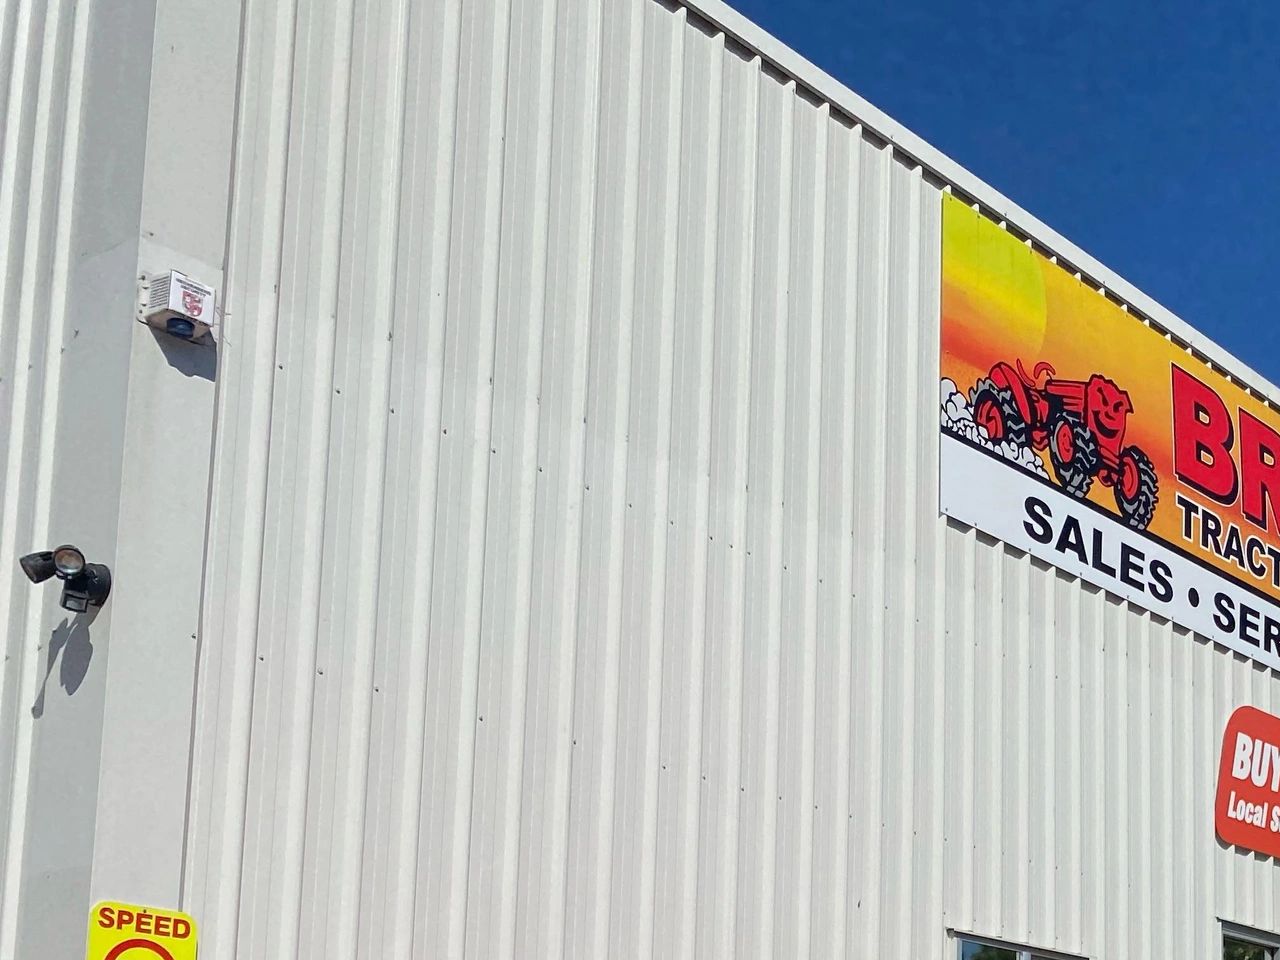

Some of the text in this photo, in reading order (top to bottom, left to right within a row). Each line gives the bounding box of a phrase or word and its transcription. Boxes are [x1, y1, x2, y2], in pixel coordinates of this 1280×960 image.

[1023, 496, 1174, 603] SALES
[1227, 790, 1268, 828] Local
[98, 907, 191, 939] SPEED
